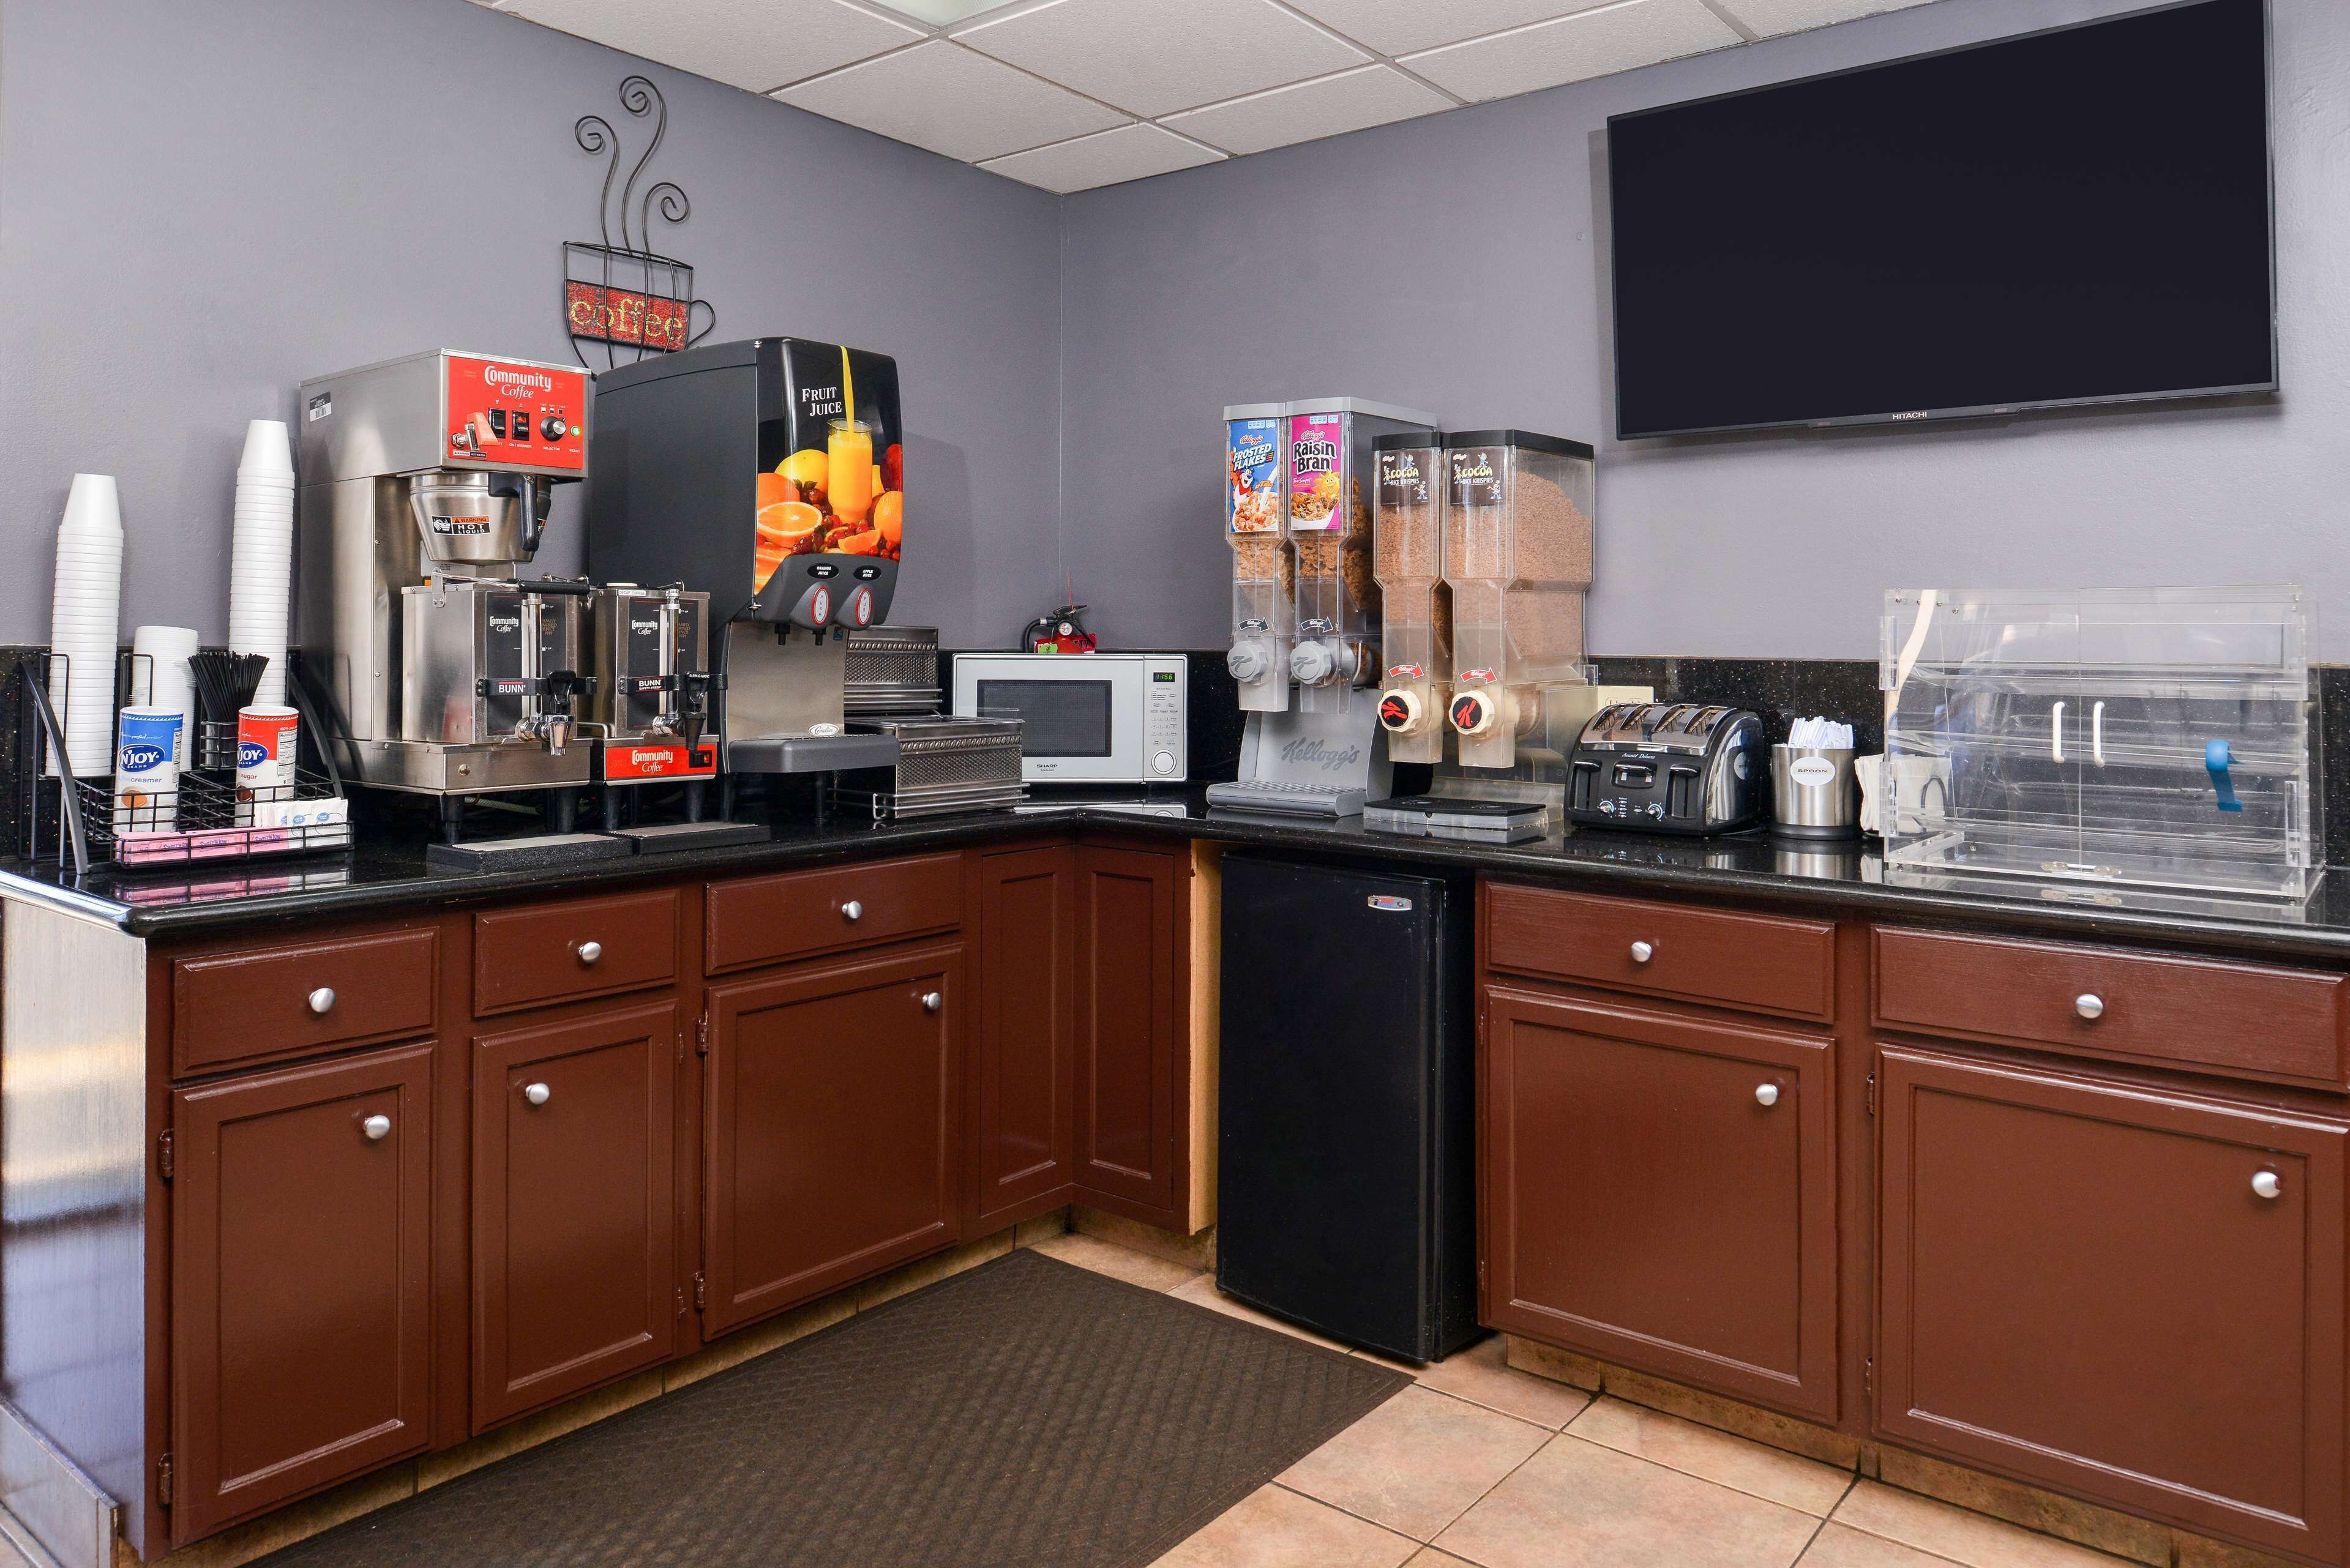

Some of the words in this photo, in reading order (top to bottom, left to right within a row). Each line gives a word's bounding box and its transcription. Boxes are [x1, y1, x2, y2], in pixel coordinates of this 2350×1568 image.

[572, 299, 682, 340] coffee
[485, 365, 552, 392] Community
[501, 384, 534, 400] Coffee
[1233, 443, 1273, 463] FROSTED
[1293, 441, 1336, 460] Raisin
[1234, 454, 1267, 471] FLAKES
[1298, 457, 1330, 473] Bran
[1390, 468, 1419, 479] COCOA
[1462, 466, 1493, 477] COCOA
[490, 616, 519, 627] Community
[632, 620, 657, 630] Community
[499, 684, 526, 693] BUNN
[632, 749, 673, 765] Community
[1281, 736, 1360, 771] Kellogg's
[642, 761, 663, 774] Coffee
